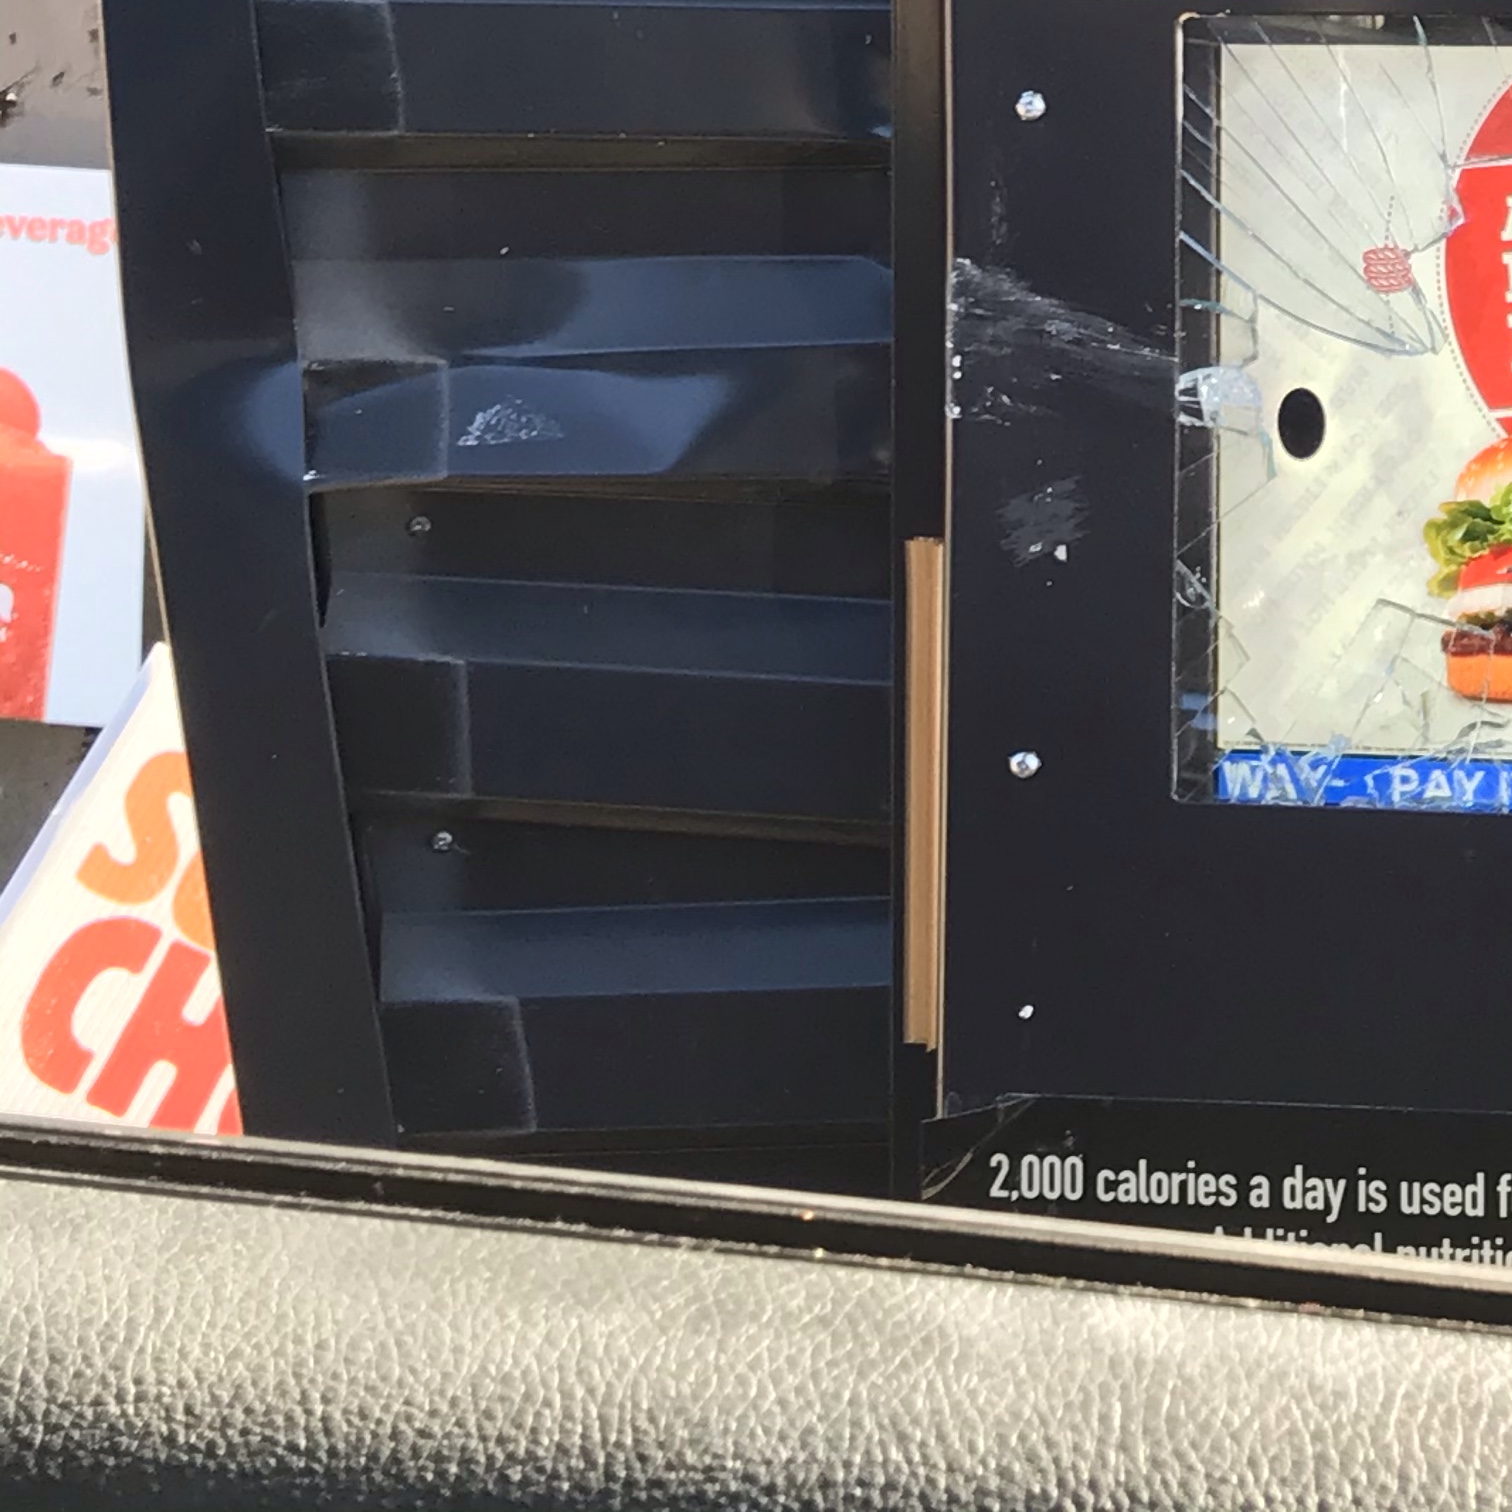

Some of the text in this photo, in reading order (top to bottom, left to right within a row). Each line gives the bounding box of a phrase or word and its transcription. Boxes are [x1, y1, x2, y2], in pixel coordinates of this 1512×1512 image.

[0, 214, 117, 256] verag
[1391, 768, 1485, 806] PAY
[20, 915, 243, 1136] CH
[989, 1152, 1083, 1203] 2,000
[1096, 1160, 1237, 1208] calories
[1248, 1178, 1270, 1210] a
[1282, 1163, 1344, 1223] day
[1356, 1166, 1388, 1214] is
[1400, 1169, 1485, 1219] used
